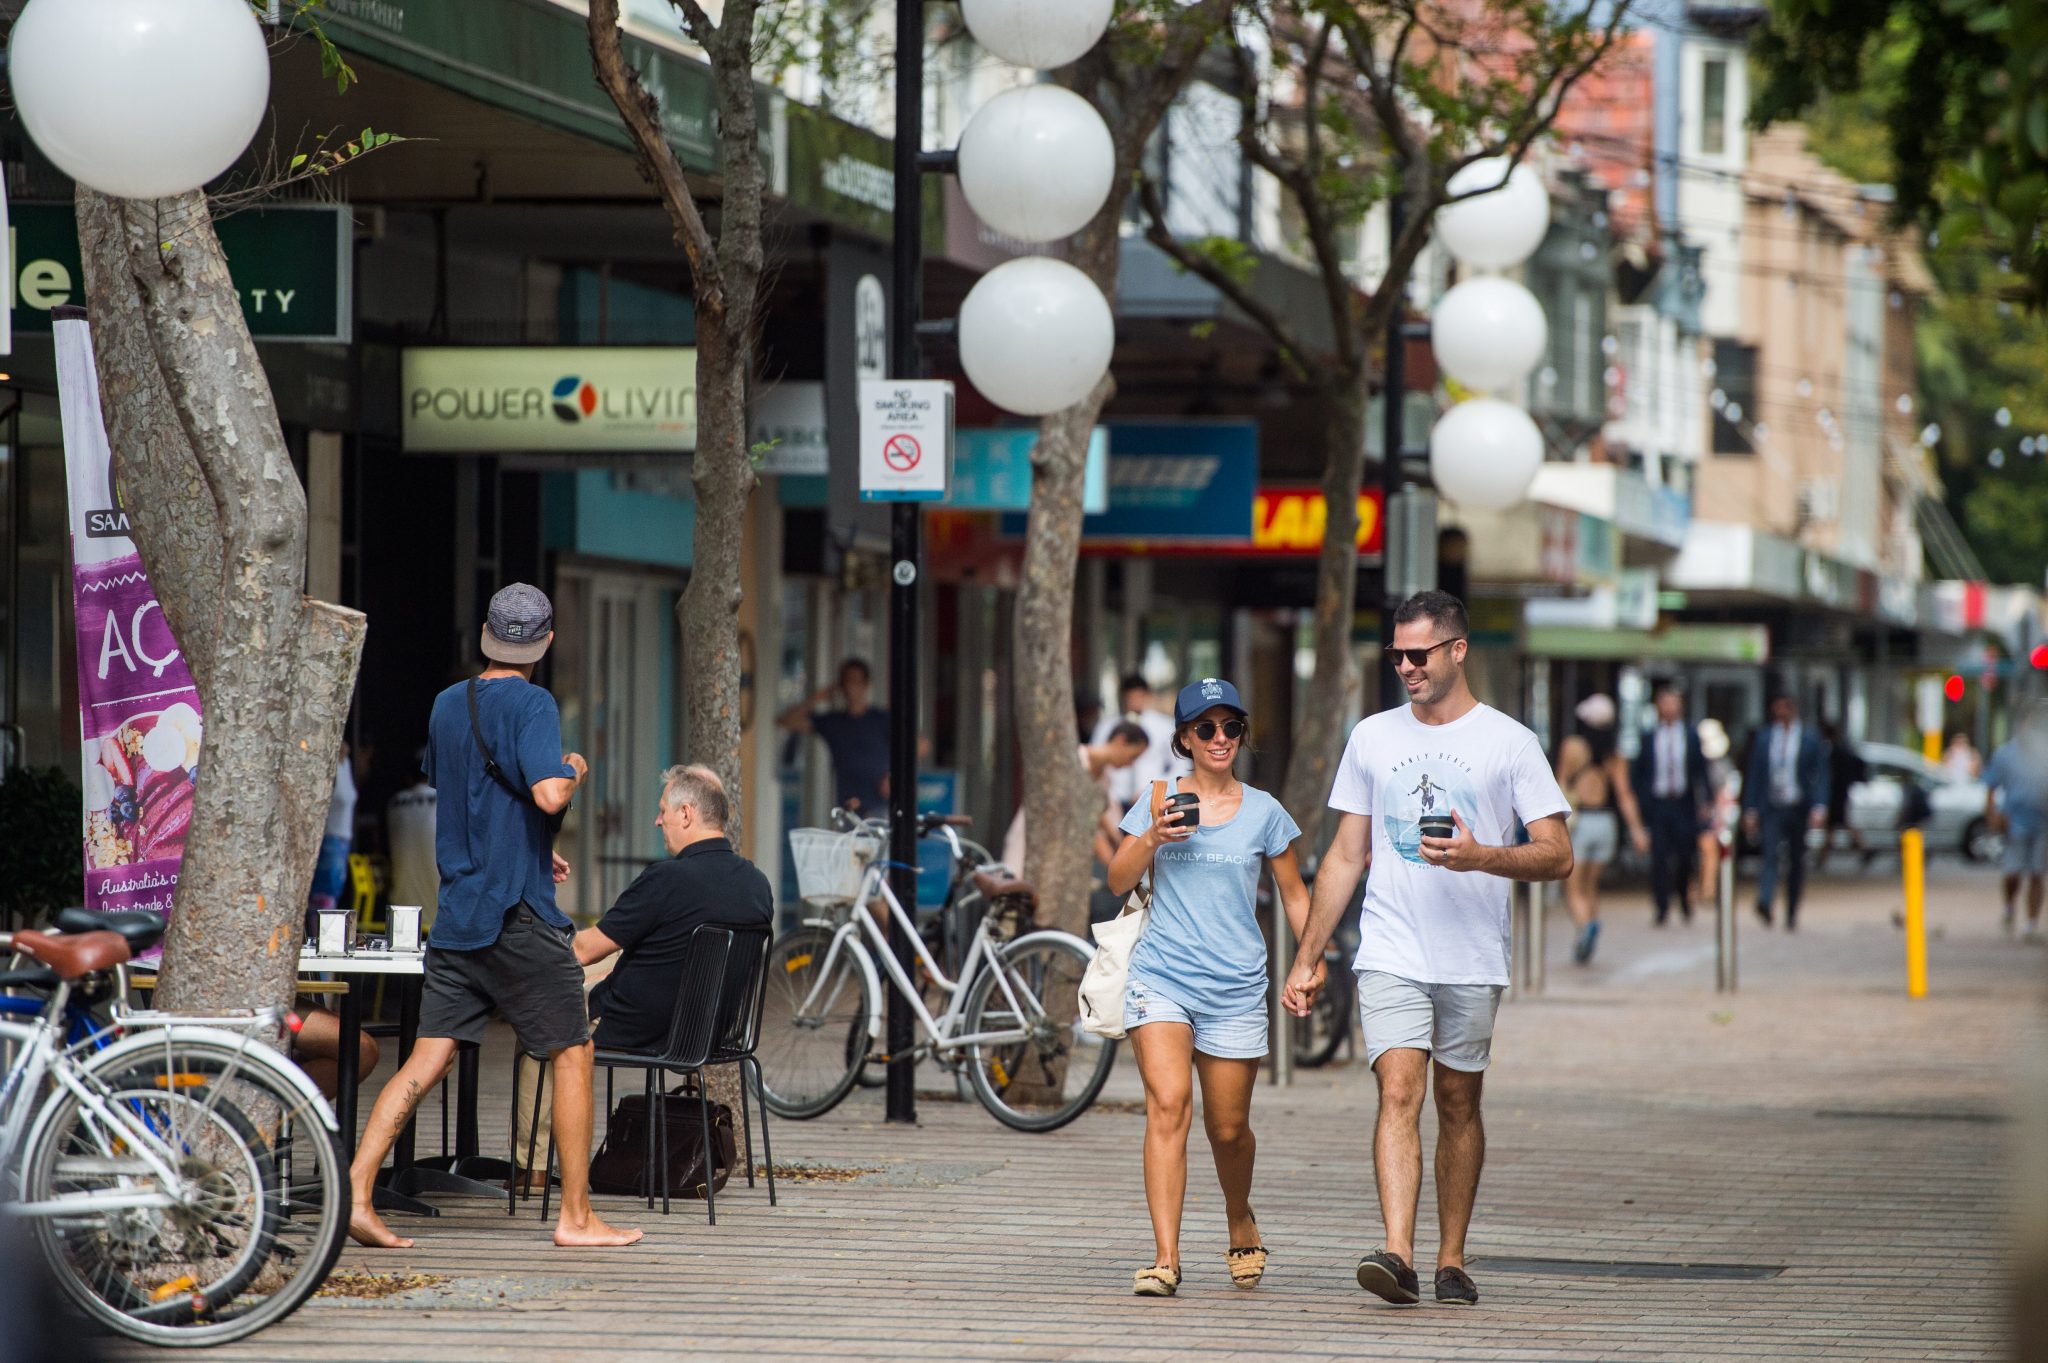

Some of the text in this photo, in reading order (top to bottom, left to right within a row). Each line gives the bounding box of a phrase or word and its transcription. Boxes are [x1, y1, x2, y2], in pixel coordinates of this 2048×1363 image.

[235, 288, 296, 313] TY
[894, 389, 912, 399] NO
[410, 387, 545, 421] POWER
[875, 400, 931, 410] SMOKING
[887, 412, 918, 421] AREA
[1391, 752, 1472, 773] MANLY BEACH
[1160, 851, 1202, 862] MANLY
[1206, 853, 1251, 865] BEACH
[97, 870, 169, 896] Australia's
[132, 895, 164, 913] trade
